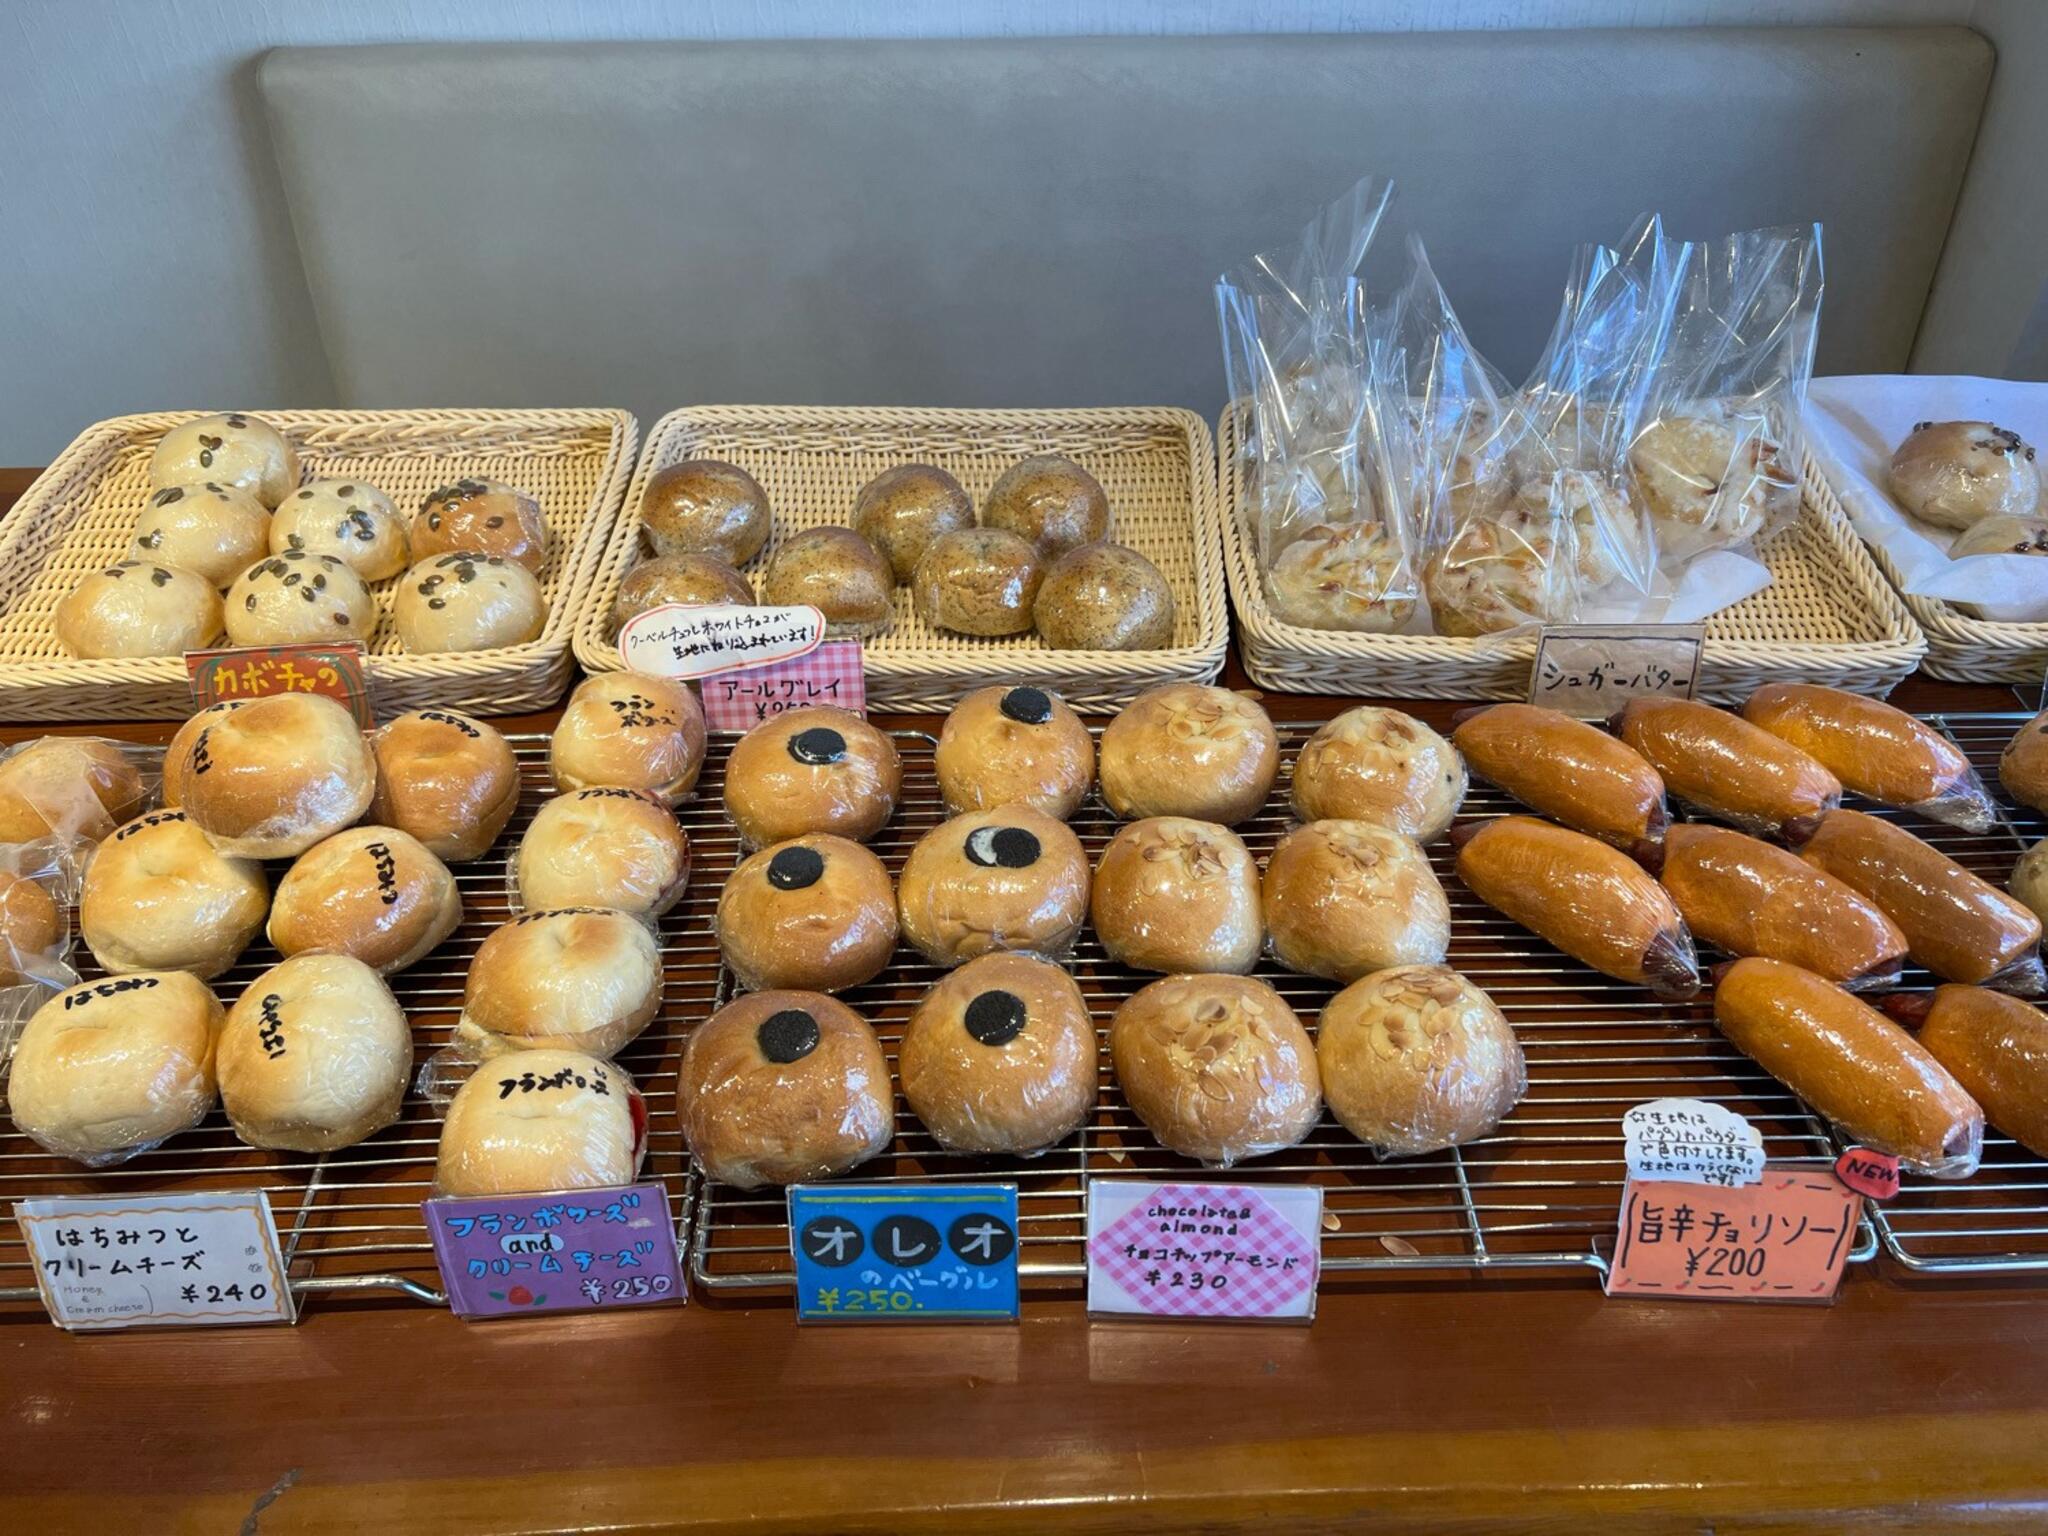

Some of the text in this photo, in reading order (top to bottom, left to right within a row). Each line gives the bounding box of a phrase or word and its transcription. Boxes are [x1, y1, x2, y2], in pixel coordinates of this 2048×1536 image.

[213, 660, 339, 695] カボチャの
[719, 678, 842, 701] アールグレイ
[1543, 661, 1689, 691] シュガーバター
[446, 1192, 640, 1238] フランボワーズ
[1159, 1219, 1238, 1236] almond
[1638, 1200, 1836, 1246] 旨辛チョリソー
[56, 1226, 199, 1249] はちみつと
[508, 1232, 554, 1254] and
[812, 1221, 1007, 1261] オレオ
[43, 1249, 206, 1278] クリームチーズ
[1684, 1246, 1767, 1277] ¥200
[580, 1273, 673, 1305] ¥250
[860, 1265, 1000, 1292] のベーグル
[1144, 1269, 1228, 1290] ¥230
[180, 1283, 268, 1304] ¥240
